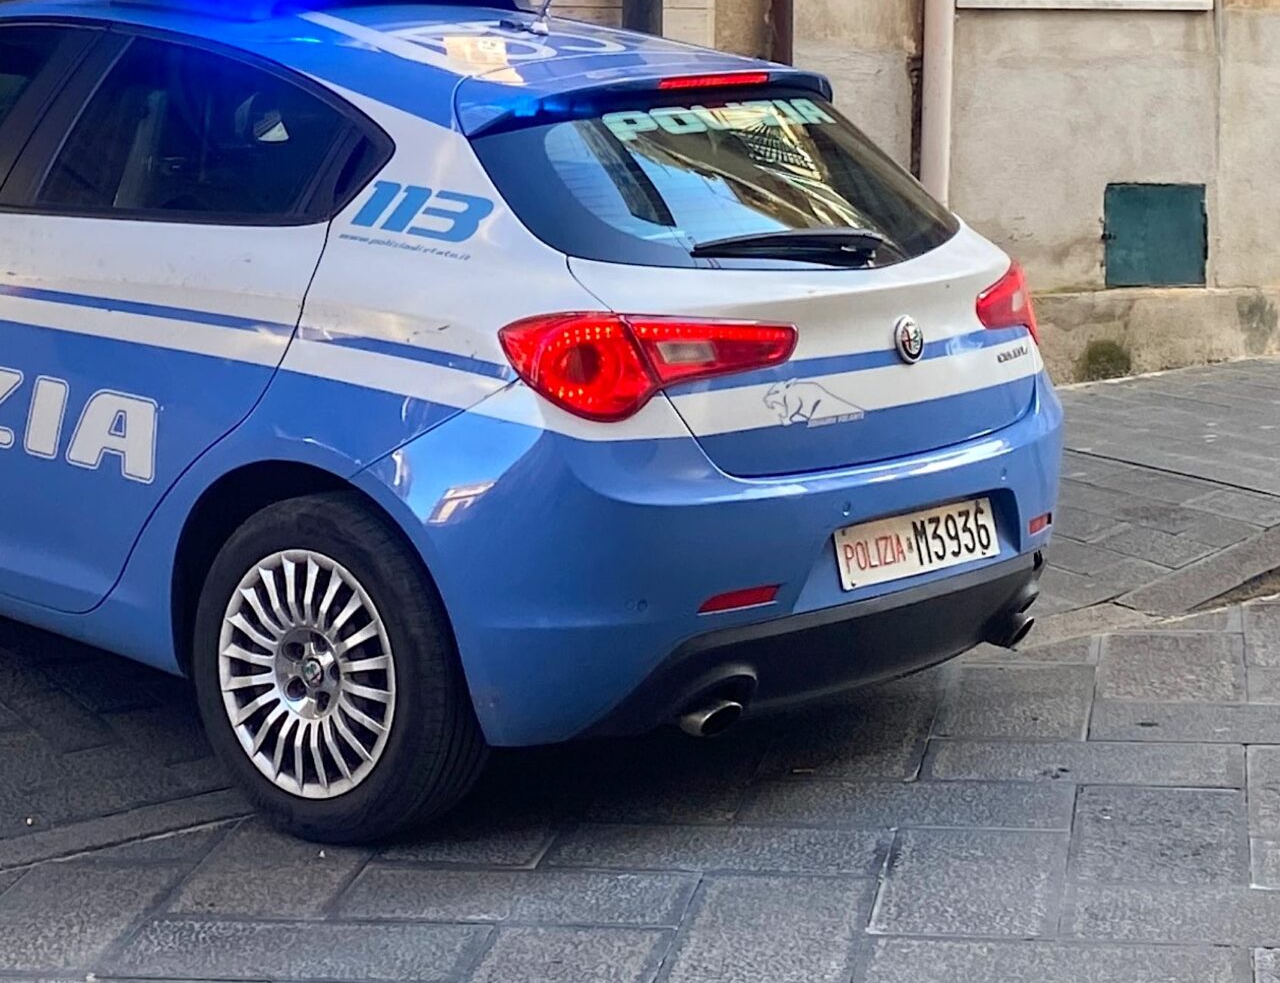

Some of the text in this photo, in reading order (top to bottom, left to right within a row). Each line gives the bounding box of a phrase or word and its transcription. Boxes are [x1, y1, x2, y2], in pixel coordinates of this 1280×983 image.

[350, 179, 495, 244] 113
[843, 505, 992, 574] POLIZIA M3936
